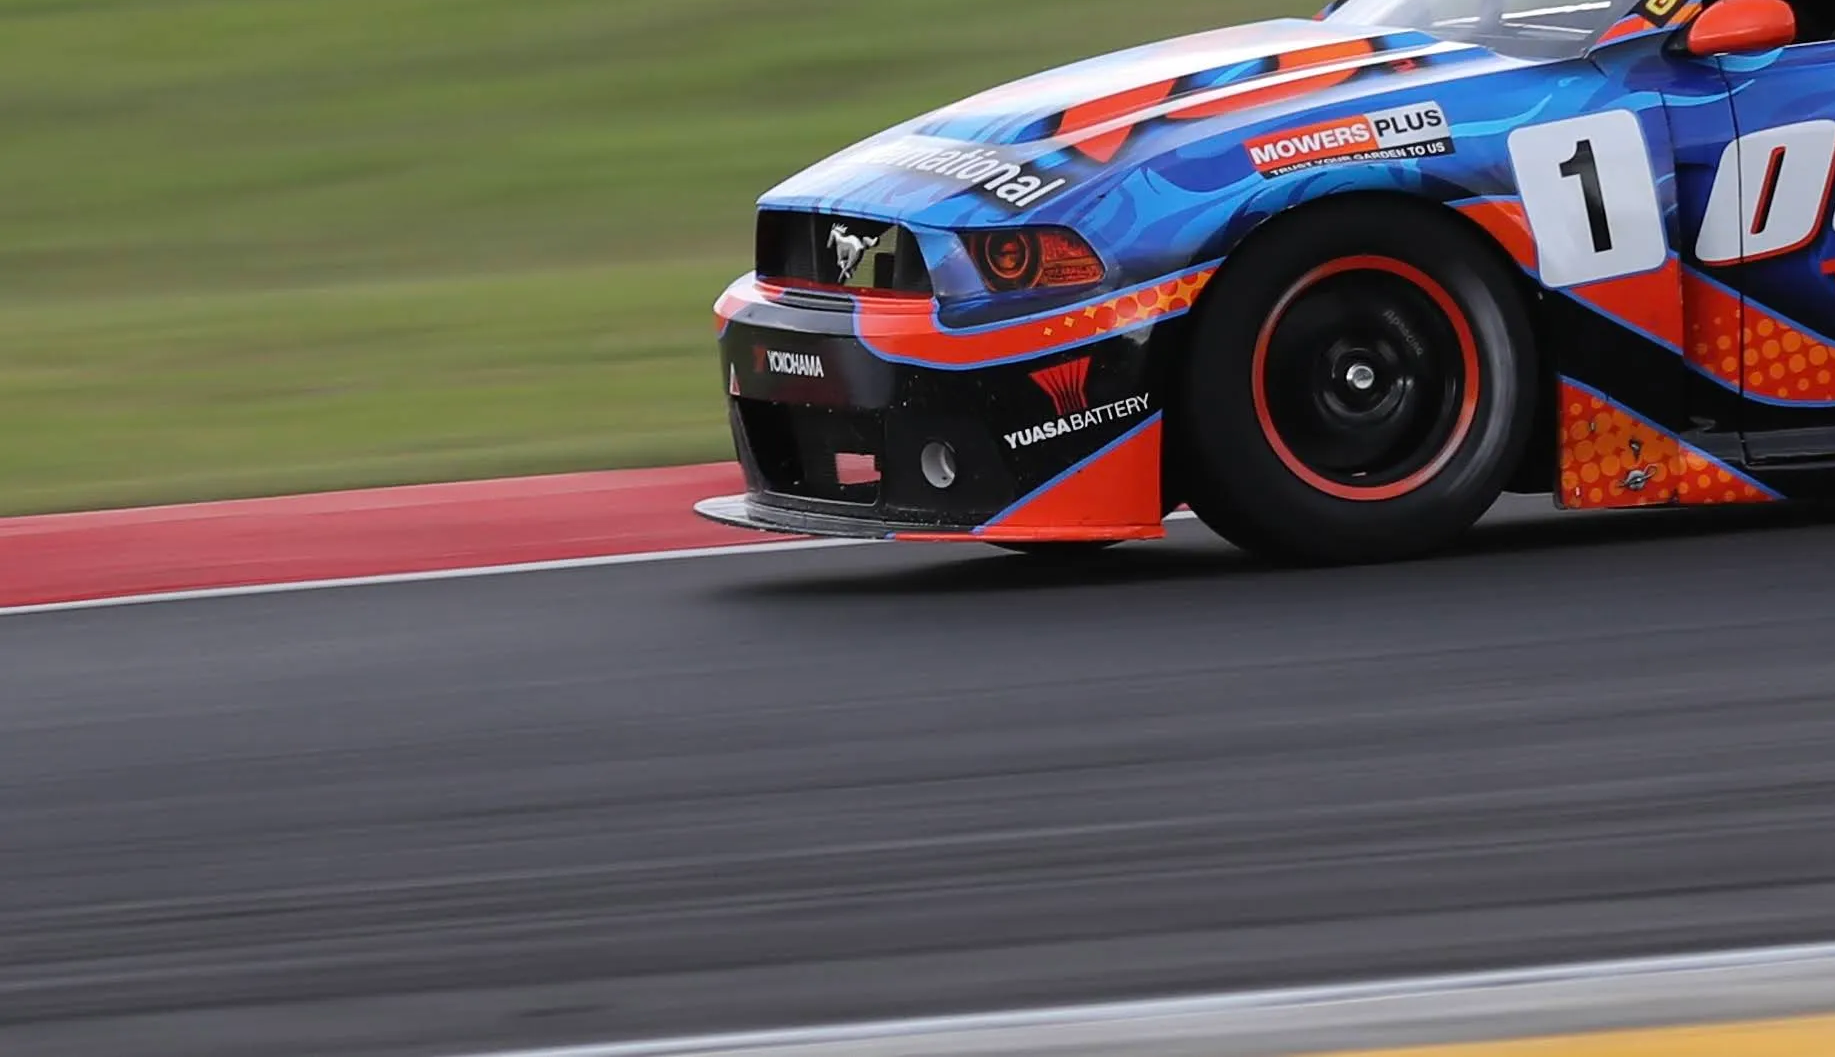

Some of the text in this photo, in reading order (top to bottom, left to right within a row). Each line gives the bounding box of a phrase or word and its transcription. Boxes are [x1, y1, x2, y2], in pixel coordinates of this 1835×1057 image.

[1250, 109, 1442, 165] MOWERS PLUS
[1270, 161, 1312, 176] TRUST
[1353, 149, 1407, 161] GARDEN
[1408, 145, 1426, 157] TO
[1429, 142, 1446, 154] US
[1559, 139, 1613, 253] 1
[766, 349, 825, 378] YOKOHAMA
